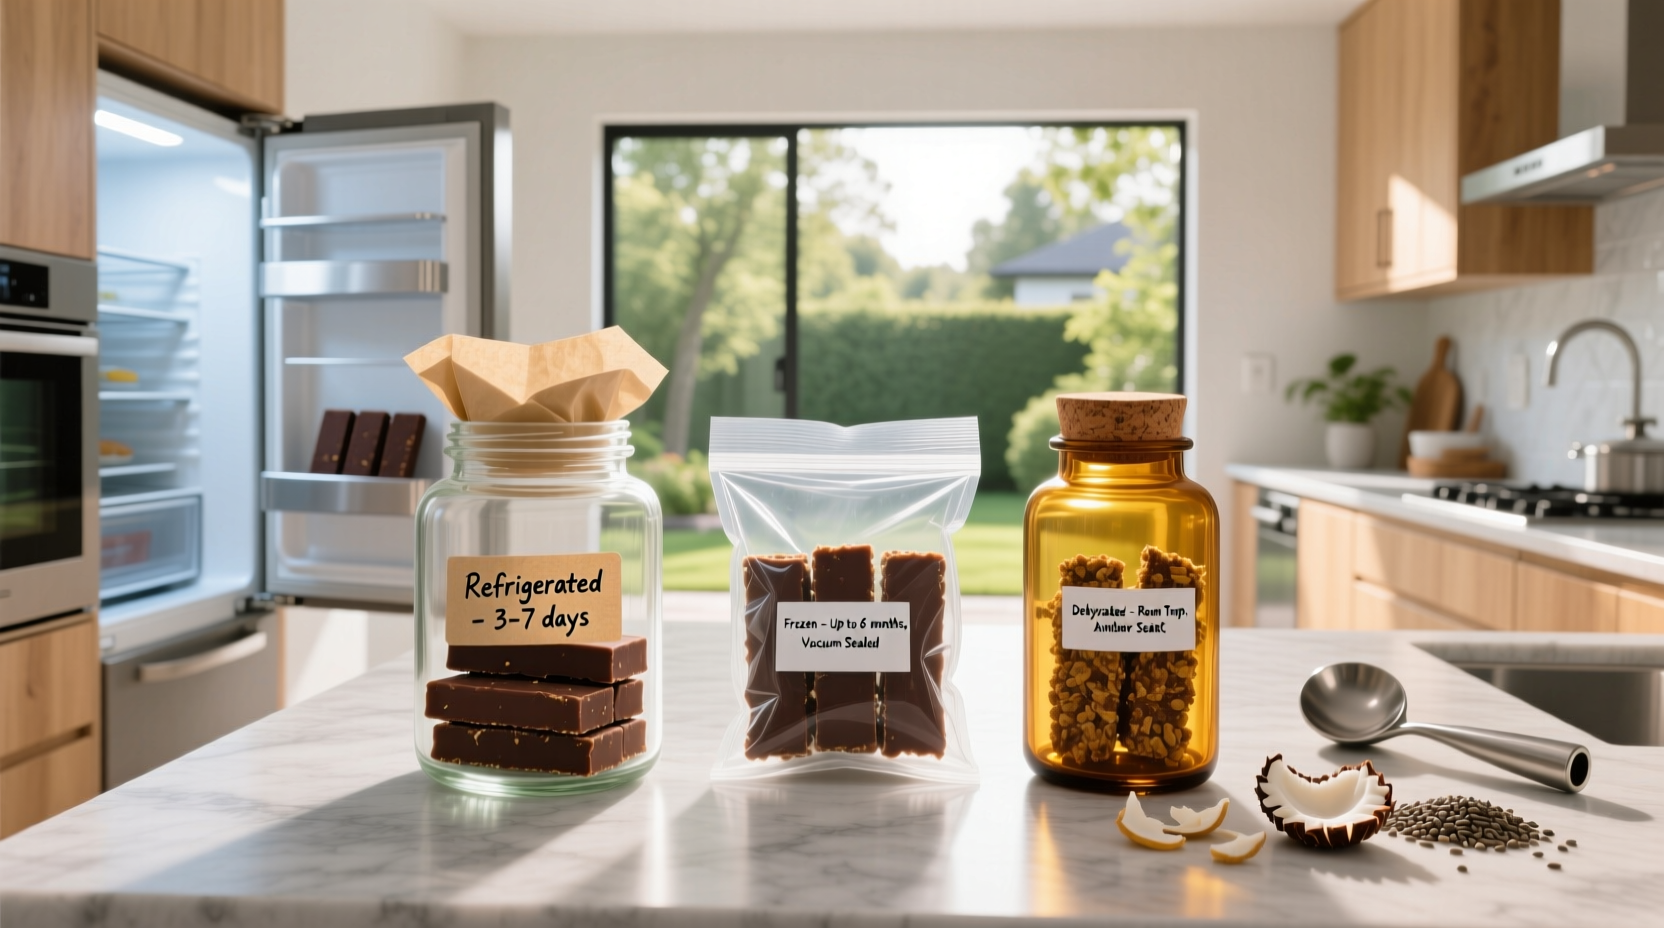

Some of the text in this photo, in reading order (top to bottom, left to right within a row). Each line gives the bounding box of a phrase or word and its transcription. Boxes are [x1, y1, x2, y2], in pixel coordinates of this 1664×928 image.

[465, 568, 603, 604] Refrigerated
[542, 604, 590, 638] days
[830, 617, 845, 632] Up
[846, 618, 857, 630] to
[859, 617, 867, 630] 6
[845, 636, 880, 649] Sealed
